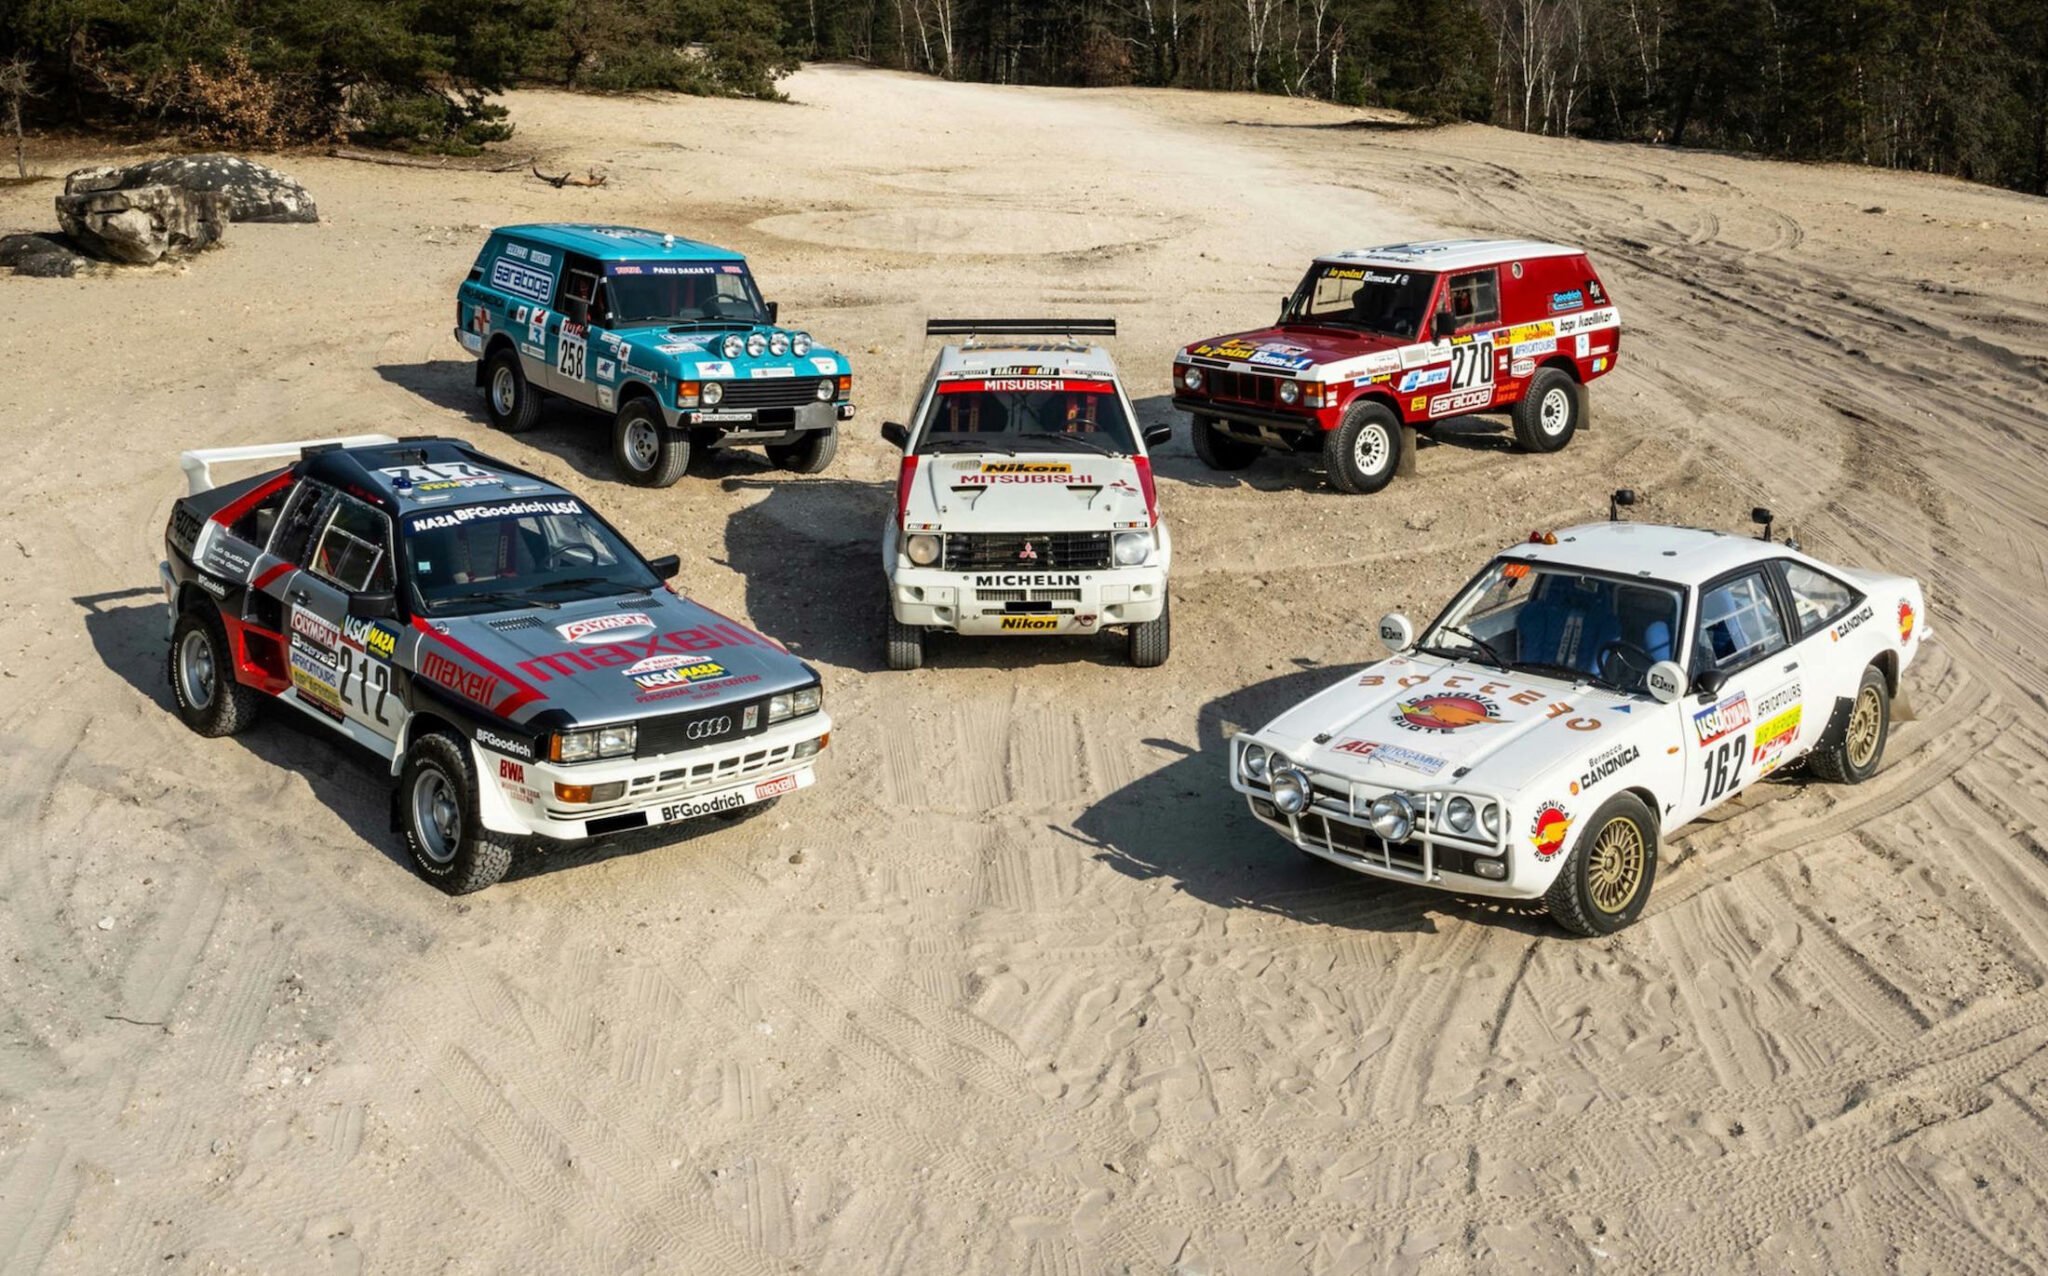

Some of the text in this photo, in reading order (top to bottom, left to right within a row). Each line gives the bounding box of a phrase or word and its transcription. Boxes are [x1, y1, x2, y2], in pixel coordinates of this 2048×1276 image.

[495, 264, 550, 301] saratoga
[559, 340, 584, 380] 258
[1452, 342, 1493, 389] 270
[984, 380, 1064, 391] MITSUBISHI
[1432, 390, 1489, 414] saratoga
[960, 475, 1093, 484] MITSUBISHI
[983, 464, 1067, 474] Nikon
[453, 501, 552, 521] BFGoodrich
[976, 575, 1080, 586] MICHELIN
[294, 612, 335, 649] OLYMPIA
[572, 614, 650, 638] OLYMPIA
[1001, 618, 1058, 629] Nikon
[1837, 606, 1875, 638] CANONICA
[517, 624, 755, 682] maxell
[339, 645, 390, 727] 212
[421, 651, 499, 706] maxell
[476, 727, 531, 758] BFGoodrich
[1337, 740, 1381, 755] AG
[499, 759, 525, 784] BWA
[1580, 745, 1641, 790] CANONICA
[1700, 734, 1746, 806] 162
[757, 776, 796, 798] maxell
[660, 793, 746, 821] BFGoodrich
